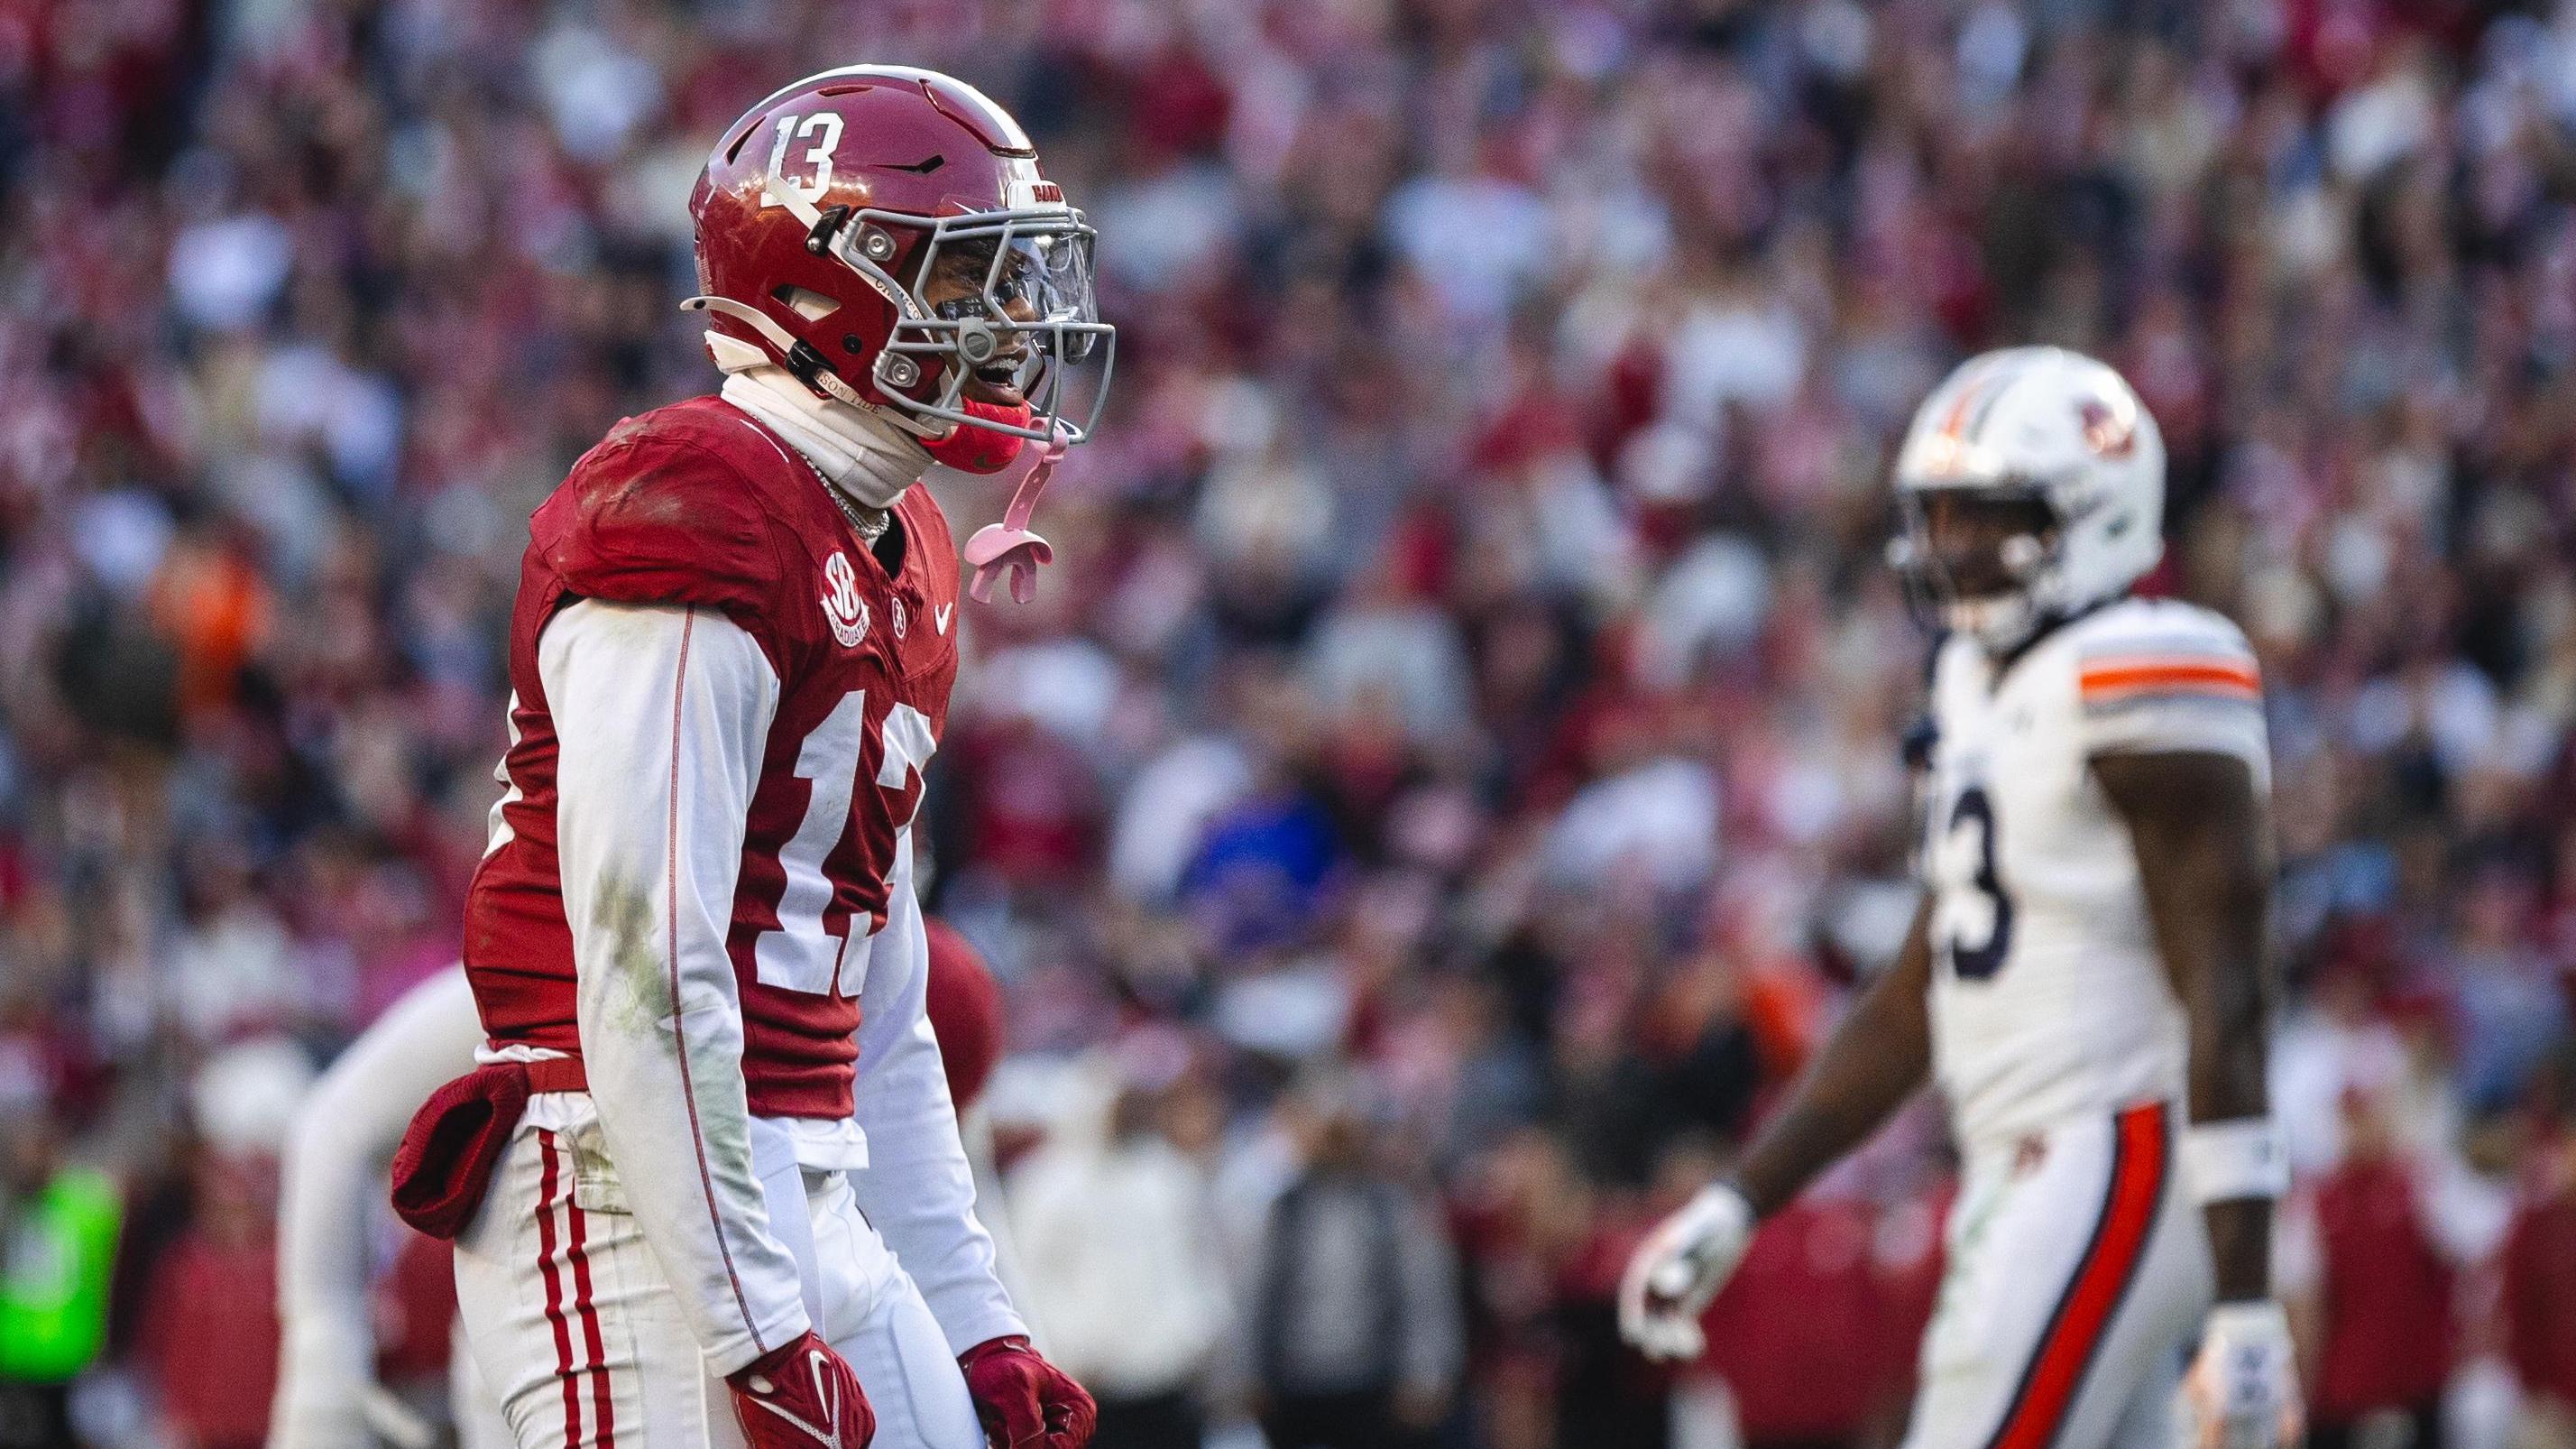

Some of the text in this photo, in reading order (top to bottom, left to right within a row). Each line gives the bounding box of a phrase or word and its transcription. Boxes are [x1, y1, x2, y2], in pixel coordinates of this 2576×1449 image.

[760, 112, 844, 208] 13
[825, 551, 861, 621] SEC
[829, 614, 868, 644] GRADUATE
